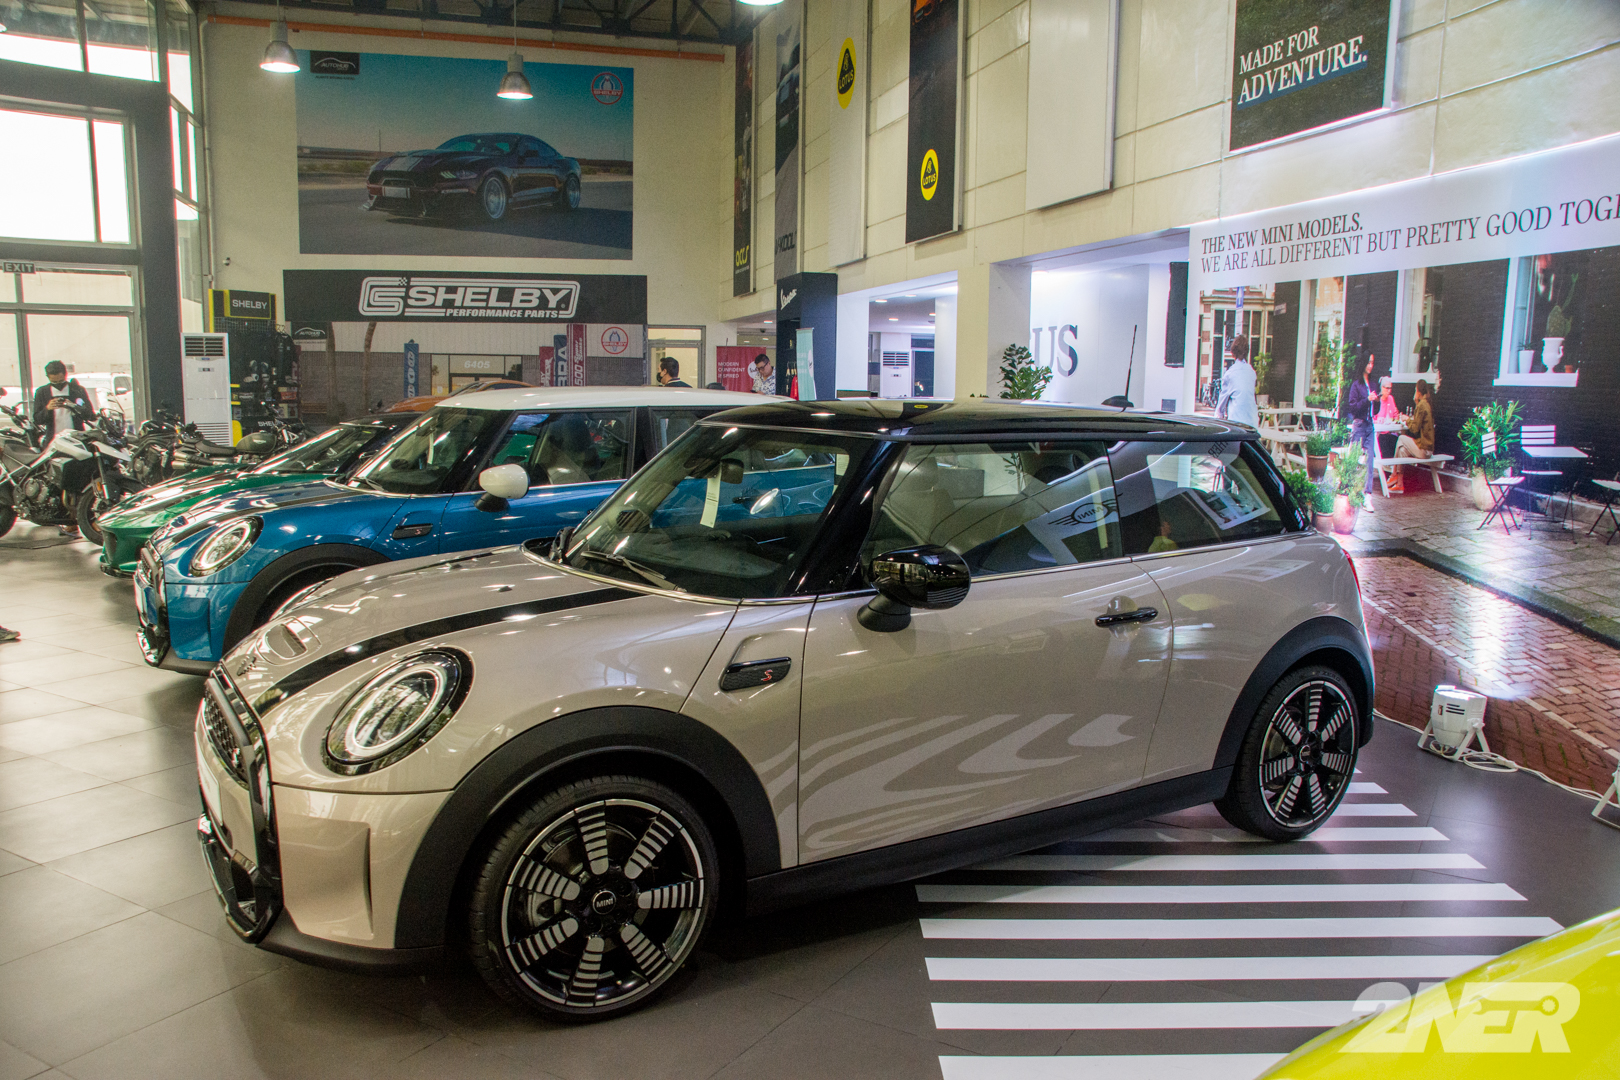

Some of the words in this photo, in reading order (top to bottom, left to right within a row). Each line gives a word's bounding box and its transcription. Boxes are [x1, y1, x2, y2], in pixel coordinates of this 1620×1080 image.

[1239, 39, 1284, 75] MADE
[1287, 25, 1319, 57] FOR
[1237, 34, 1368, 105] ADVENTURE.
[838, 69, 854, 89] LOTUS
[922, 172, 936, 186] LOTUS
[1201, 235, 1225, 254] THE
[1228, 229, 1259, 251] NEW
[1261, 223, 1294, 246] MINI
[1297, 212, 1363, 240] MODELS.
[1201, 255, 1221, 273] WE
[1223, 251, 1249, 271] ARE
[1251, 247, 1276, 268] ALL
[1279, 234, 1363, 264] DIFFERENT
[1367, 229, 1401, 253] BUT
[1405, 216, 1481, 248] PRETTY
[1485, 205, 1552, 237] GOOD
[5, 262, 34, 273] EXIT
[407, 286, 571, 308] SHELBY
[232, 299, 268, 310] SHELBY
[445, 309, 523, 318] PERFORMANCE
[524, 310, 558, 318] PARTS
[464, 360, 491, 369] 6405
[761, 669, 773, 682] S
[596, 898, 614, 908] MINI
